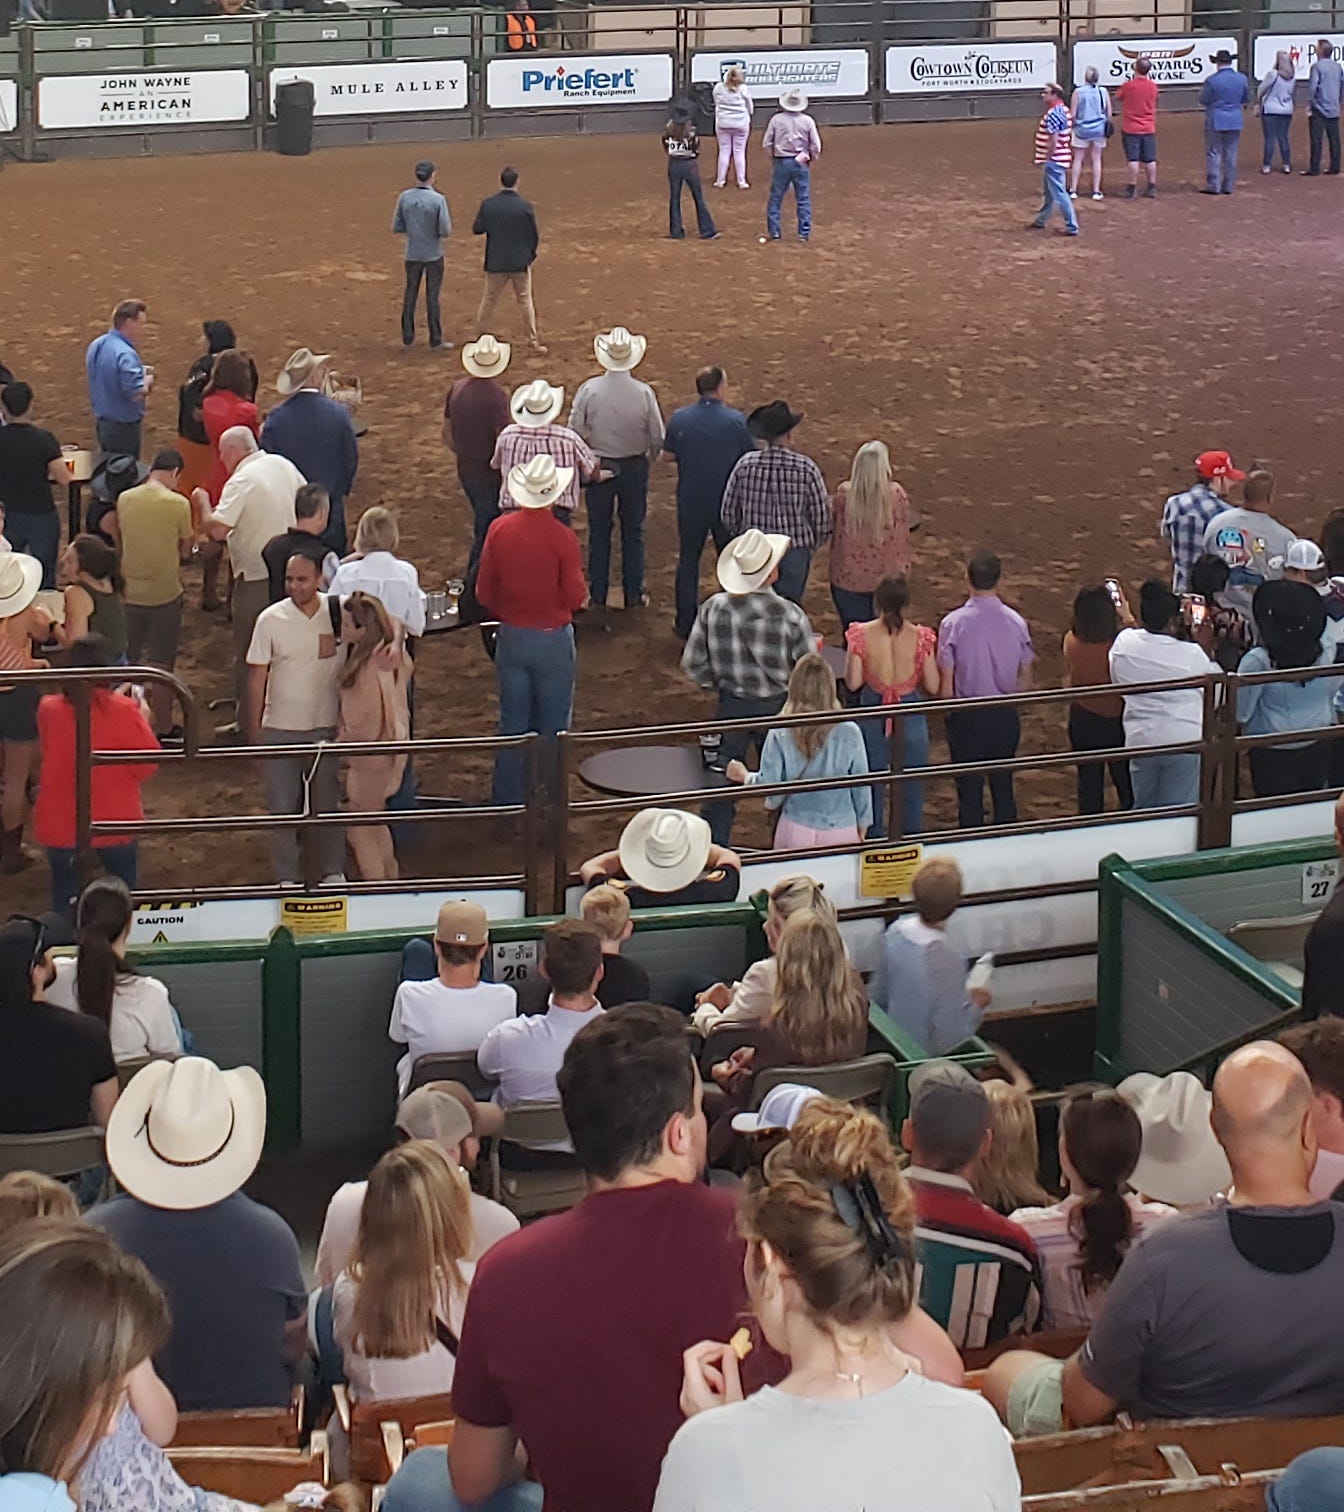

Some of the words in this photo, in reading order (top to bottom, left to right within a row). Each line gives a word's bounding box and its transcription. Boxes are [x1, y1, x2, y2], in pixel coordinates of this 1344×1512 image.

[746, 62, 840, 75] ULTIMATE
[100, 79, 137, 88] JOHN
[143, 77, 191, 87] WAYNE
[522, 66, 635, 92] Priefert
[1125, 72, 1185, 81] SWCASE
[331, 83, 385, 95] MULE
[396, 80, 458, 92] ALLEY
[592, 88, 636, 97] Equipment
[101, 98, 191, 111] AMERICAN
[99, 111, 191, 121] EXPERIENCE
[1310, 881, 1330, 898] 27
[297, 902, 342, 911] WARNING
[137, 916, 184, 925] CAUTION
[502, 964, 527, 982] 26
